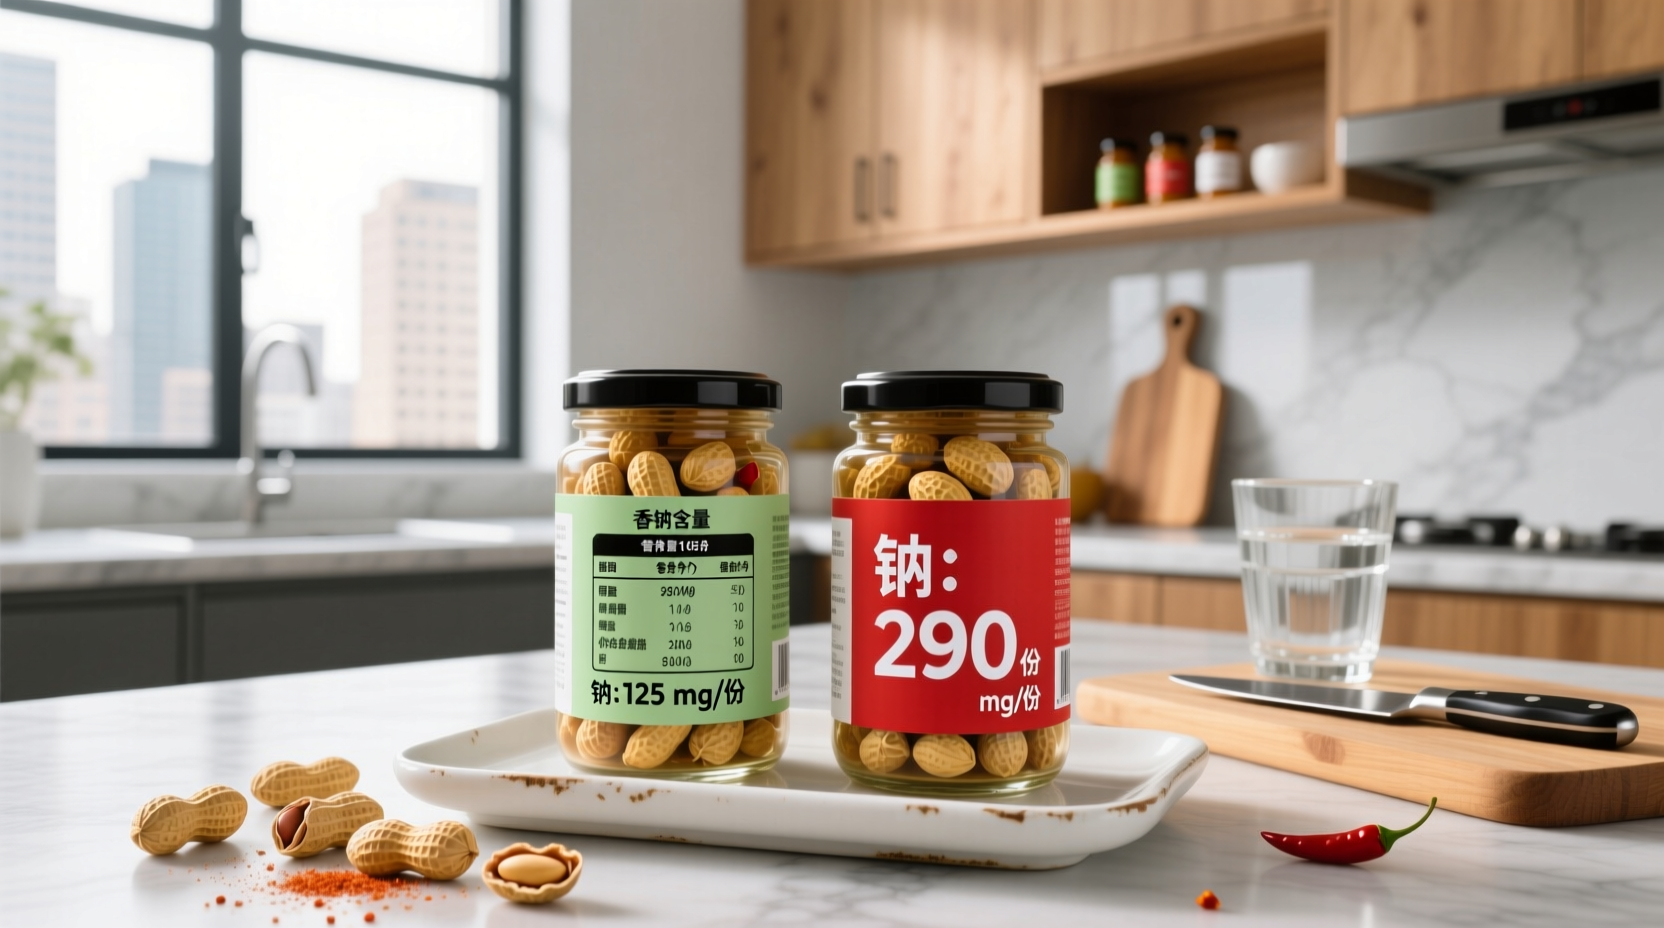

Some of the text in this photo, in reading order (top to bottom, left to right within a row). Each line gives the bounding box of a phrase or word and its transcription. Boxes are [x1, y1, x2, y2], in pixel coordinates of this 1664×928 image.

[874, 533, 958, 598] 钠:
[874, 609, 1041, 680] 290 份
[591, 678, 745, 711] 钠:125 mg/份
[979, 684, 1041, 718] mg/份
